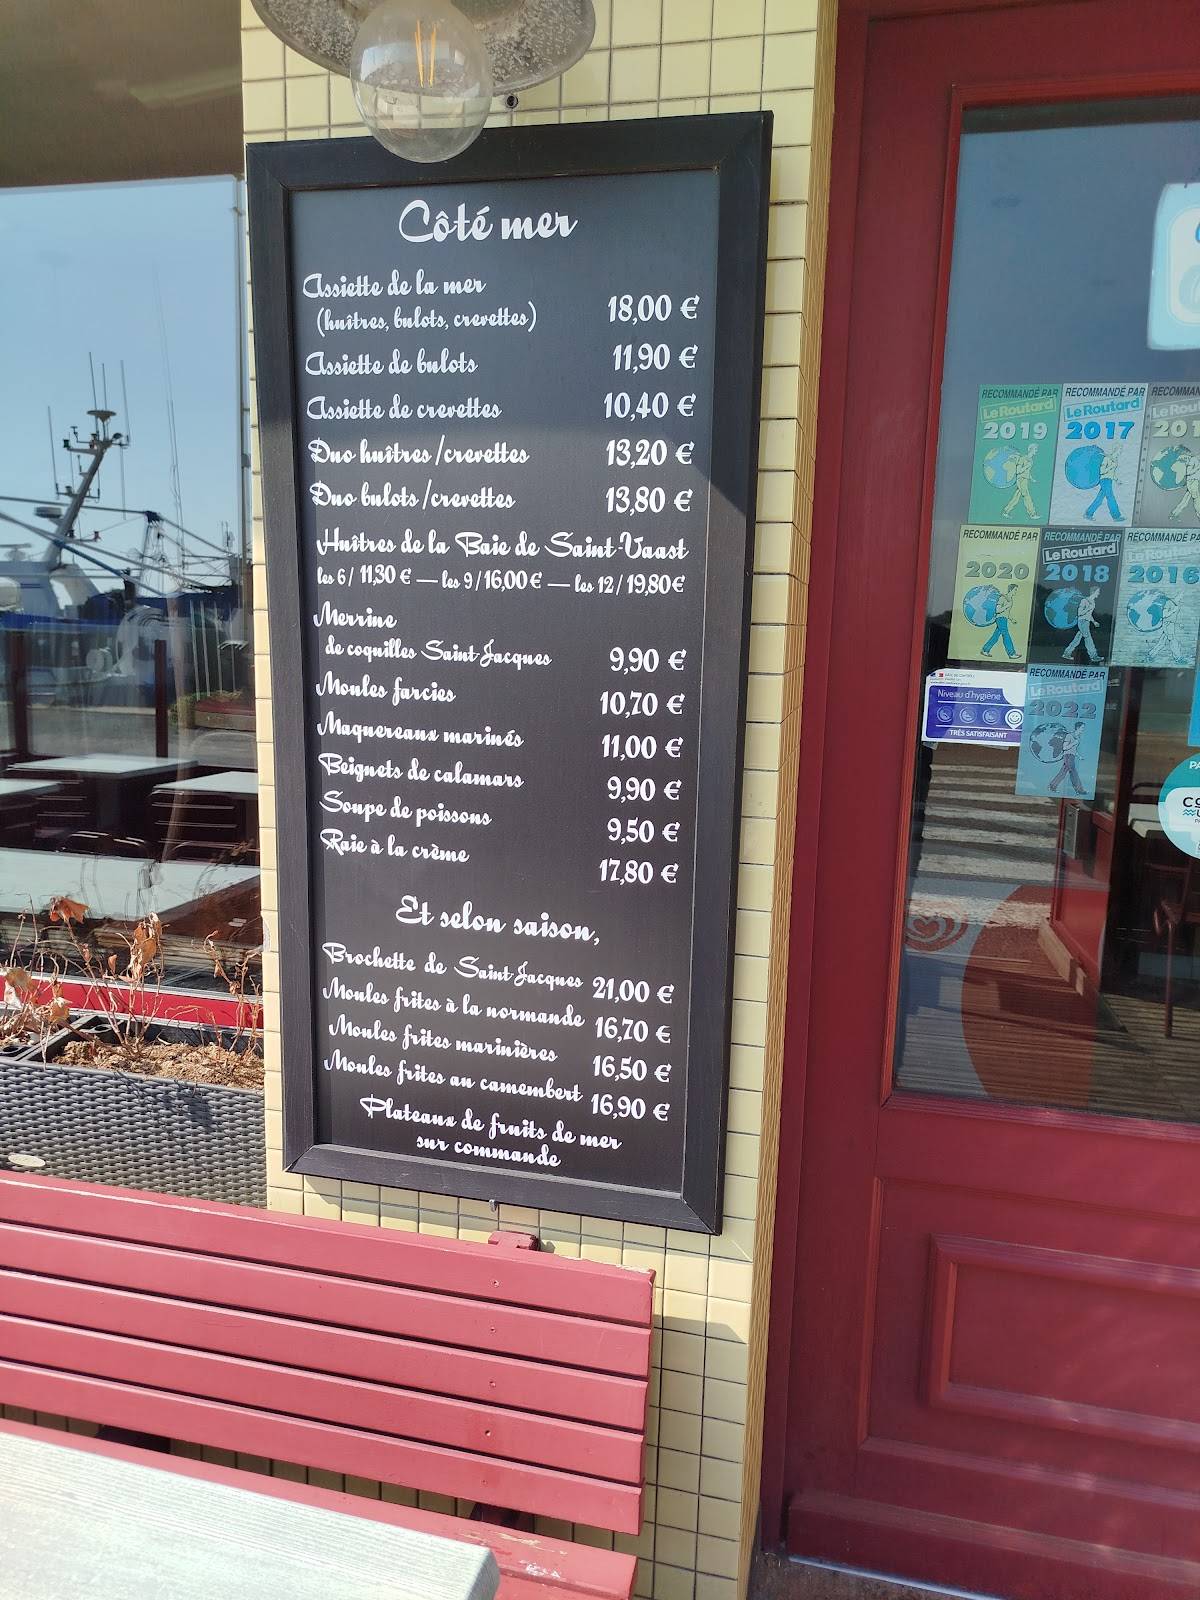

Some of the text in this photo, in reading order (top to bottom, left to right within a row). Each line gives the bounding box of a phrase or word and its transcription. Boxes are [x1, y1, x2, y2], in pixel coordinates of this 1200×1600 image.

[398, 199, 579, 243] Côté mer
[302, 268, 487, 299] Assiette de la mer
[316, 300, 537, 338] (huîtres, bulots, crevettes)
[607, 294, 701, 326] 18,00 €
[304, 347, 479, 376] Assiette de bulots
[612, 342, 699, 374] 11,90 €
[982, 387, 1059, 399] RECOMMANDÉ PAR
[1065, 385, 1146, 398] RECOMMANDÉ PAR
[306, 393, 503, 420] Assiette de crevettes
[603, 391, 697, 422] 10,40 €
[983, 421, 1048, 440] 2019
[1065, 421, 1135, 440] 2017
[307, 437, 357, 464] Duo
[605, 438, 695, 470] 13,20 €
[309, 480, 358, 507] Duo
[360, 481, 420, 508] bulots
[605, 485, 694, 517] 13,80 €
[316, 526, 397, 556] Huîtres
[400, 528, 425, 554] de
[428, 528, 451, 555] la
[454, 531, 512, 558] Baie
[514, 530, 541, 557] de
[963, 529, 1039, 541] RECOMMANDÉ PAR
[1044, 531, 1121, 542] RECOMMANDÉ PAR
[1128, 531, 1188, 542] RECOMMANDÉ
[316, 566, 335, 585] les
[399, 567, 412, 585] €
[441, 569, 462, 589] les
[574, 573, 595, 594] les
[965, 560, 1029, 580] 2020
[1044, 563, 1110, 583] 2018
[1128, 565, 1200, 584] 2016
[312, 600, 398, 629] Merrine
[324, 634, 345, 656] de
[346, 637, 418, 663] coquilles
[609, 646, 687, 676] 9,90 €
[315, 670, 457, 707] Moules farcies
[1029, 668, 1106, 680] RECOMMANDÉ PAR
[599, 690, 686, 719] 10,70 €
[938, 689, 964, 698] Niveau
[1028, 700, 1097, 719] 2022
[316, 710, 525, 748] Maquereaux marinés
[966, 731, 1008, 739] SATISFAISANT
[601, 733, 684, 762] 11,00 €
[317, 752, 525, 789] Beignets de calamars
[606, 775, 683, 804] 9,90 €
[319, 789, 493, 828] Soupe de poissons
[606, 816, 681, 845] 9,50 €
[319, 828, 470, 863] Raie à la crème
[598, 857, 680, 886] 17,80 €
[395, 894, 600, 946] Et selon saison,
[321, 941, 417, 972] Brochette
[423, 951, 448, 975] de
[322, 976, 586, 1028] Moules frites à la normande
[592, 976, 675, 1004] 21,00 €
[328, 1013, 559, 1062] Moules frites marinières
[594, 1016, 671, 1044] 16,70 €
[323, 1048, 584, 1103] Moules frites au camembert
[592, 1054, 673, 1083] 16,50 €
[359, 1093, 623, 1150] Plateaux de fruits de mer
[590, 1093, 671, 1122] 16,90 €
[416, 1135, 562, 1168] sur commande
